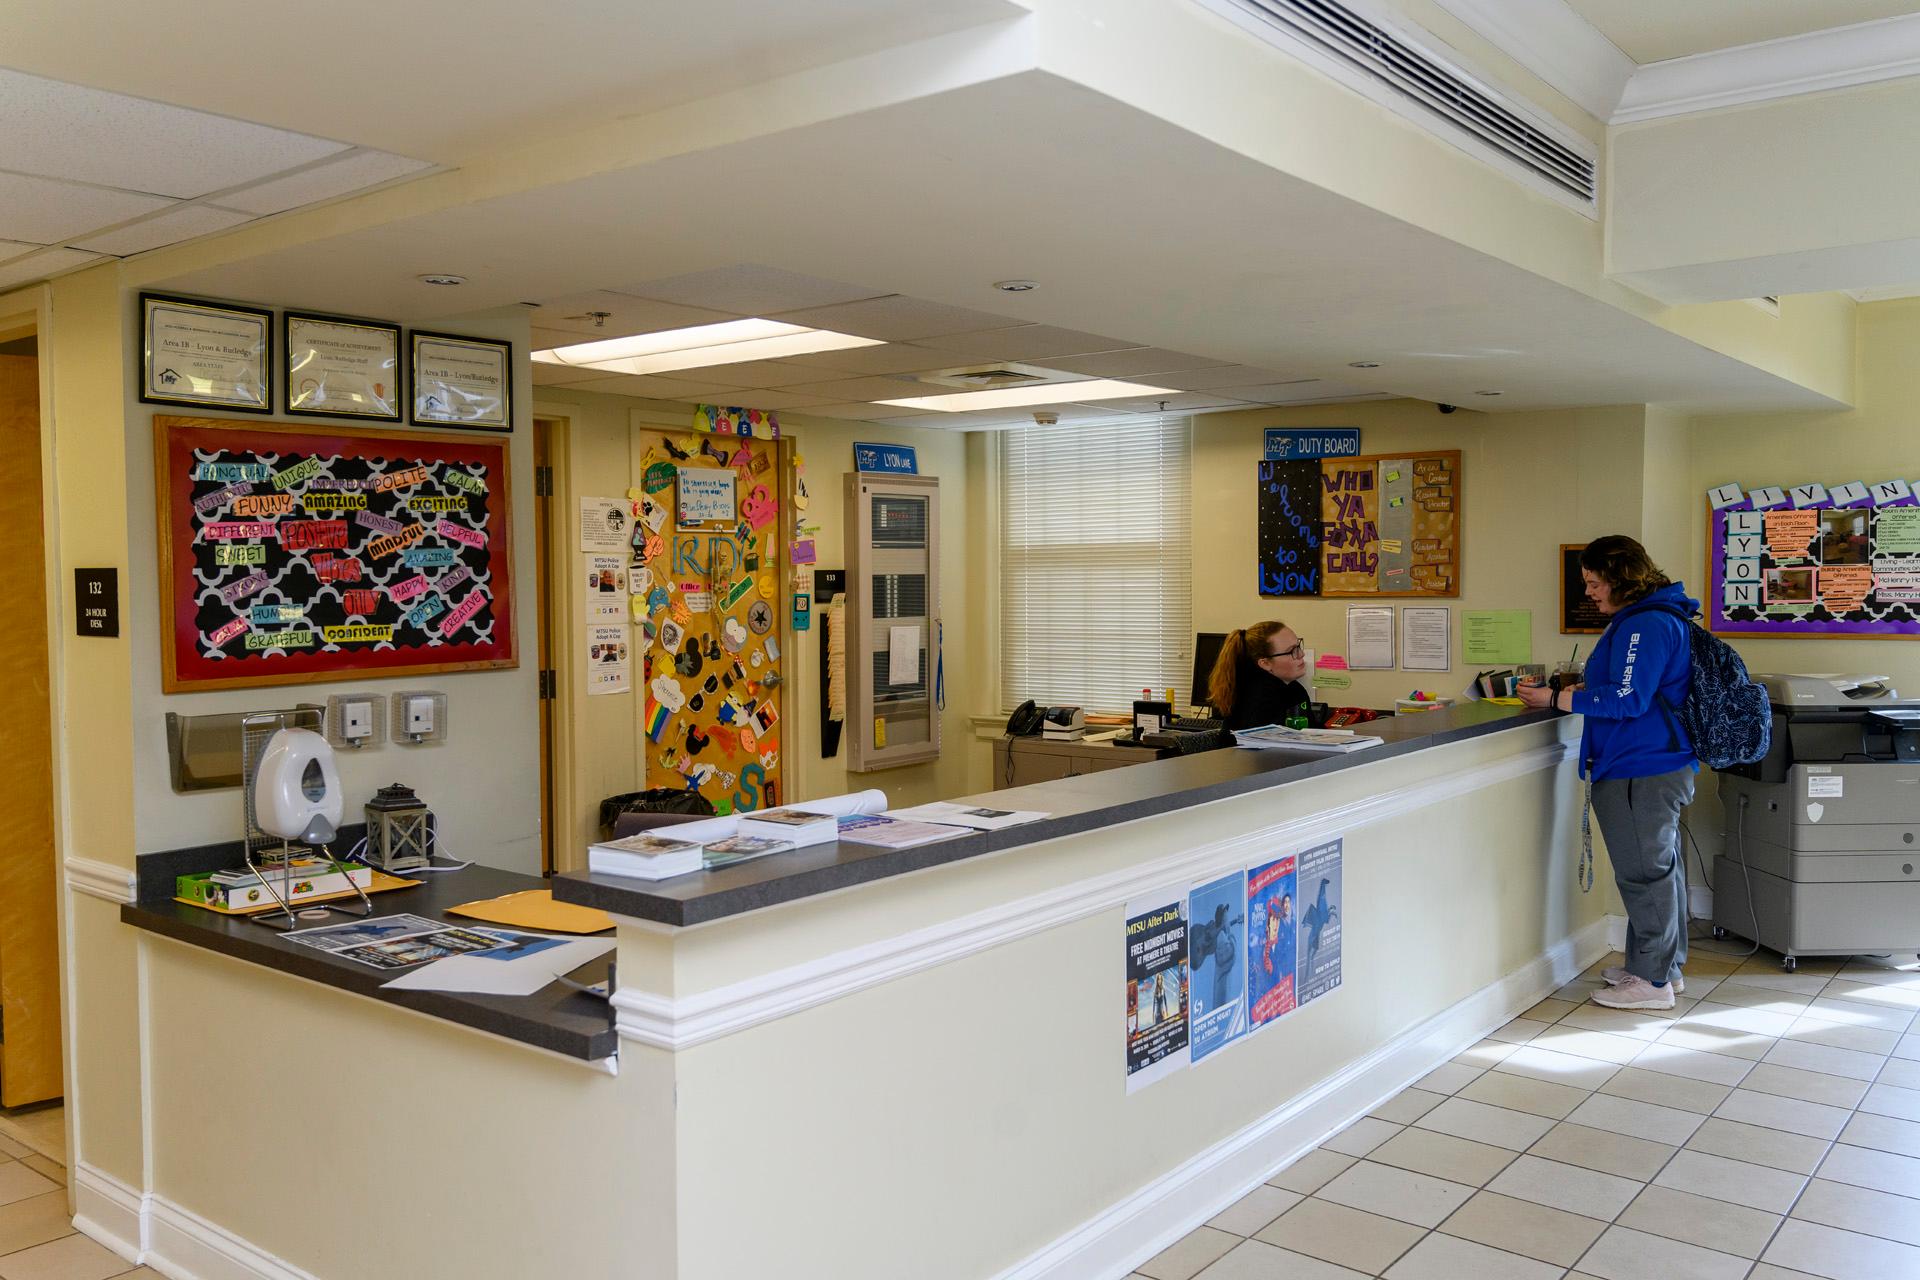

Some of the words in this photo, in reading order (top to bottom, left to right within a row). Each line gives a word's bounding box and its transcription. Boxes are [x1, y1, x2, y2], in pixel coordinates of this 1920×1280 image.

[163, 339, 179, 348] Area
[197, 343, 214, 352] Lyon
[223, 346, 252, 358] Rutledge
[1299, 438, 1322, 454] DUTY
[1324, 438, 1356, 454] BOARD
[883, 453, 901, 467] LYON
[273, 457, 321, 489] UNIQUE
[375, 466, 427, 491] POLITE
[447, 472, 482, 494] CALM
[1320, 470, 1373, 493] WHO
[196, 481, 252, 512] AUTHENTIC
[238, 497, 291, 514] FUNNY
[1332, 493, 1365, 521] YA
[209, 524, 274, 538] DIFFERENT
[359, 513, 401, 532] HONEST
[439, 522, 481, 544] HELPFUL
[216, 547, 263, 562] SWEET
[1276, 546, 1298, 565] to
[1327, 551, 1379, 577] CALL?
[89, 581, 102, 594] 132
[224, 570, 269, 599] STRONG
[394, 577, 424, 597] HAPPY
[441, 568, 465, 589] KIND
[86, 608, 91, 617] 24
[92, 608, 107, 617] HOUR
[411, 598, 440, 623] OPEN
[444, 591, 482, 634] CREATIVE
[90, 620, 102, 628] DESK
[248, 631, 313, 648] GRATEFUL
[1626, 633, 1641, 664] BLUE
[1126, 920, 1146, 937] MTSU
[1147, 916, 1163, 929] After
[1163, 907, 1179, 923] Dark
[1130, 942, 1143, 957] FREE
[1143, 933, 1166, 952] MIDNIGHT
[1166, 926, 1184, 943] MOVIES
[1137, 955, 1142, 966] AT
[1194, 1019, 1207, 1034] OPEN
[1216, 1009, 1232, 1025] NIGHT
